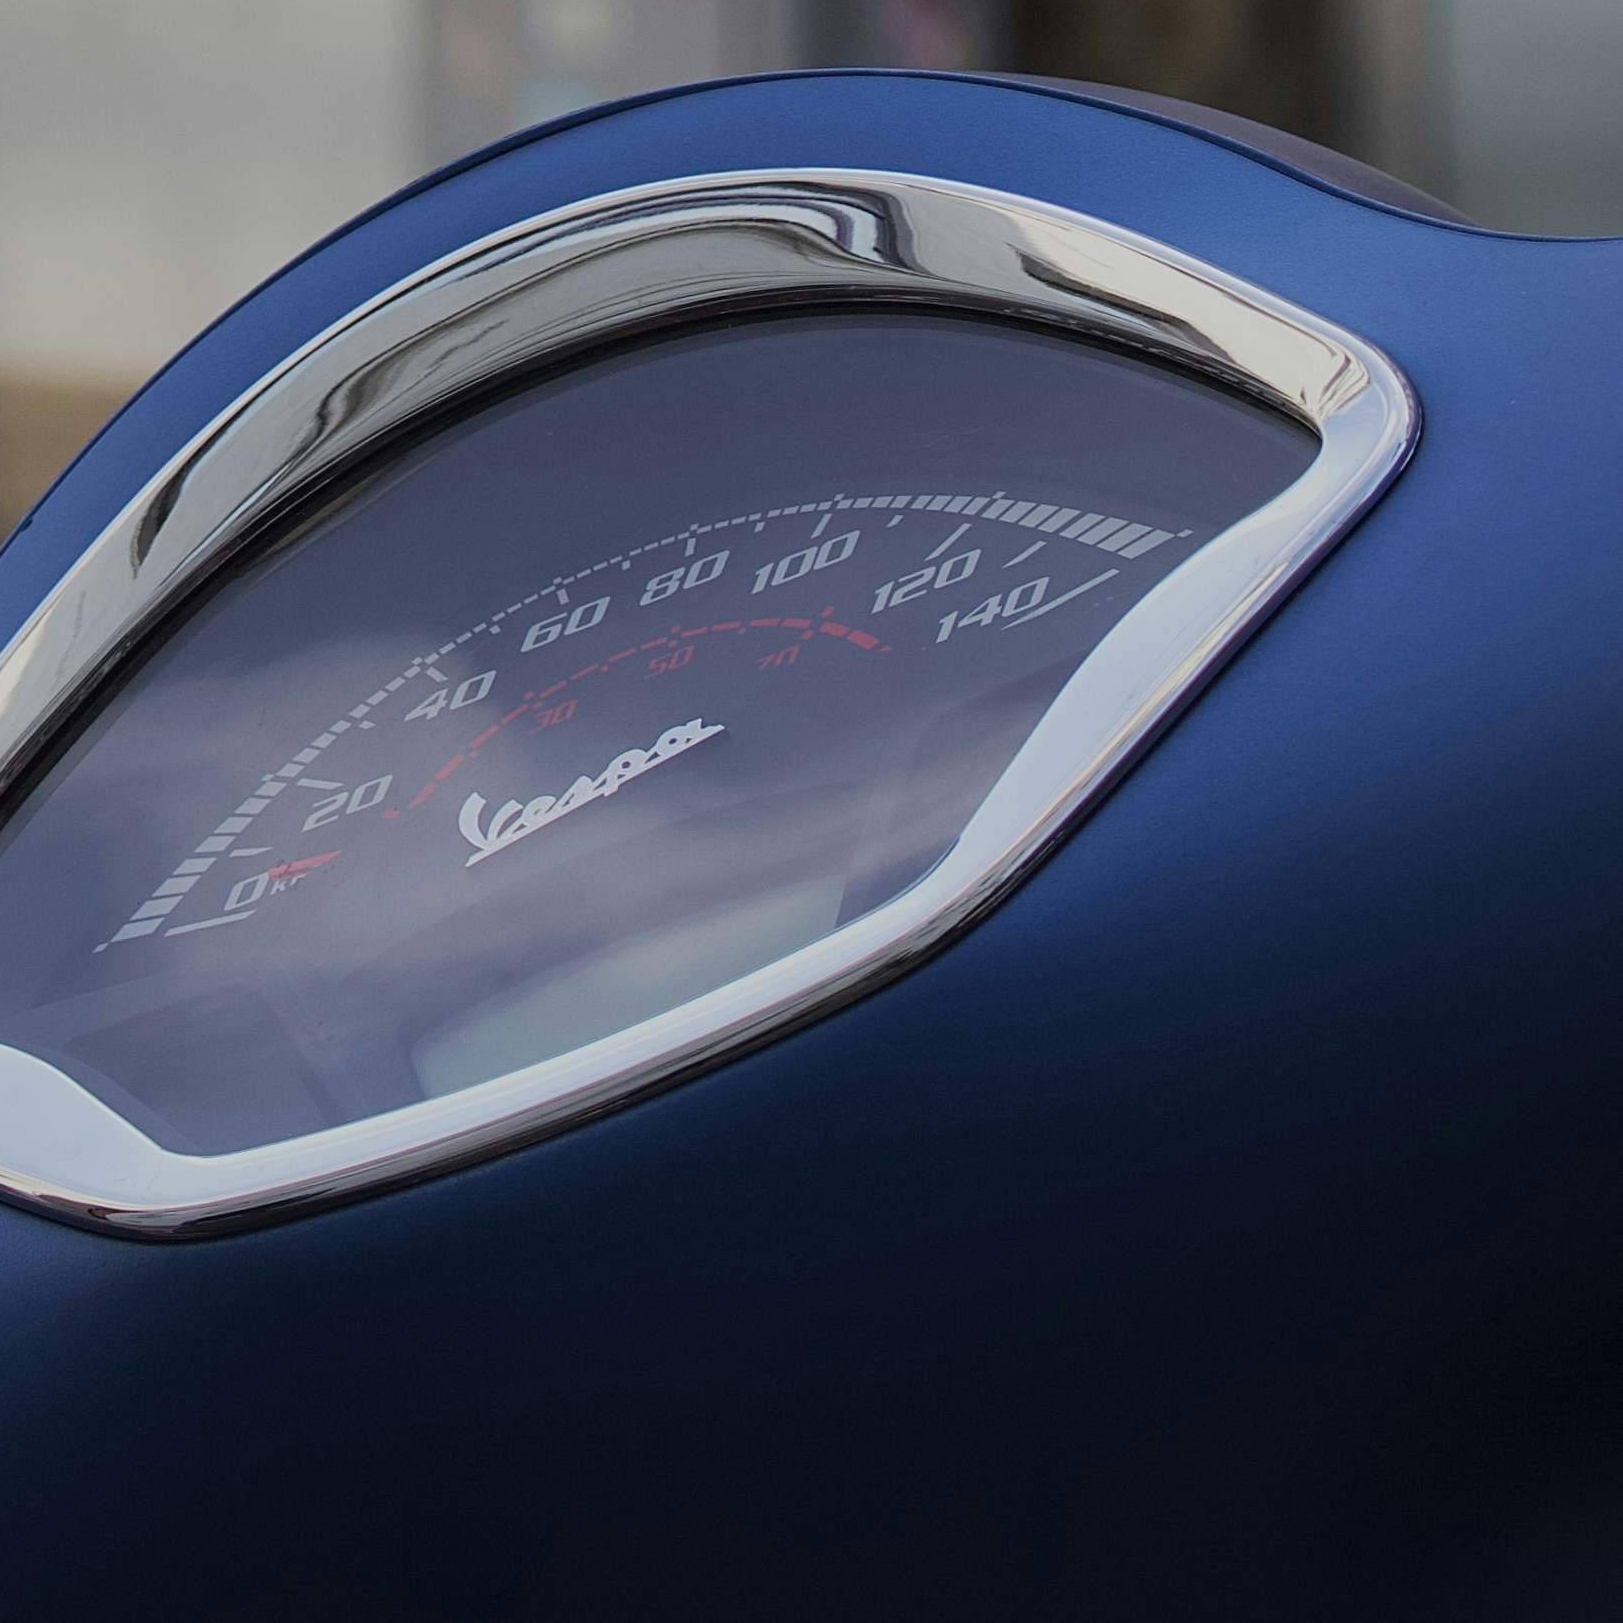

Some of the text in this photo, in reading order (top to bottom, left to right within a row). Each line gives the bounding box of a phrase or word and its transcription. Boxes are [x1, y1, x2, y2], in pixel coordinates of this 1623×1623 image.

[638, 549, 731, 607] 80
[751, 529, 861, 595] 100
[870, 548, 983, 615] 120
[519, 595, 612, 653] 60
[934, 575, 1051, 644] 140
[644, 644, 696, 681] 50
[403, 669, 497, 722] 40
[528, 699, 578, 735] 30
[301, 773, 394, 833] 20
[457, 717, 727, 869] Vespa
[223, 871, 271, 912] 0
